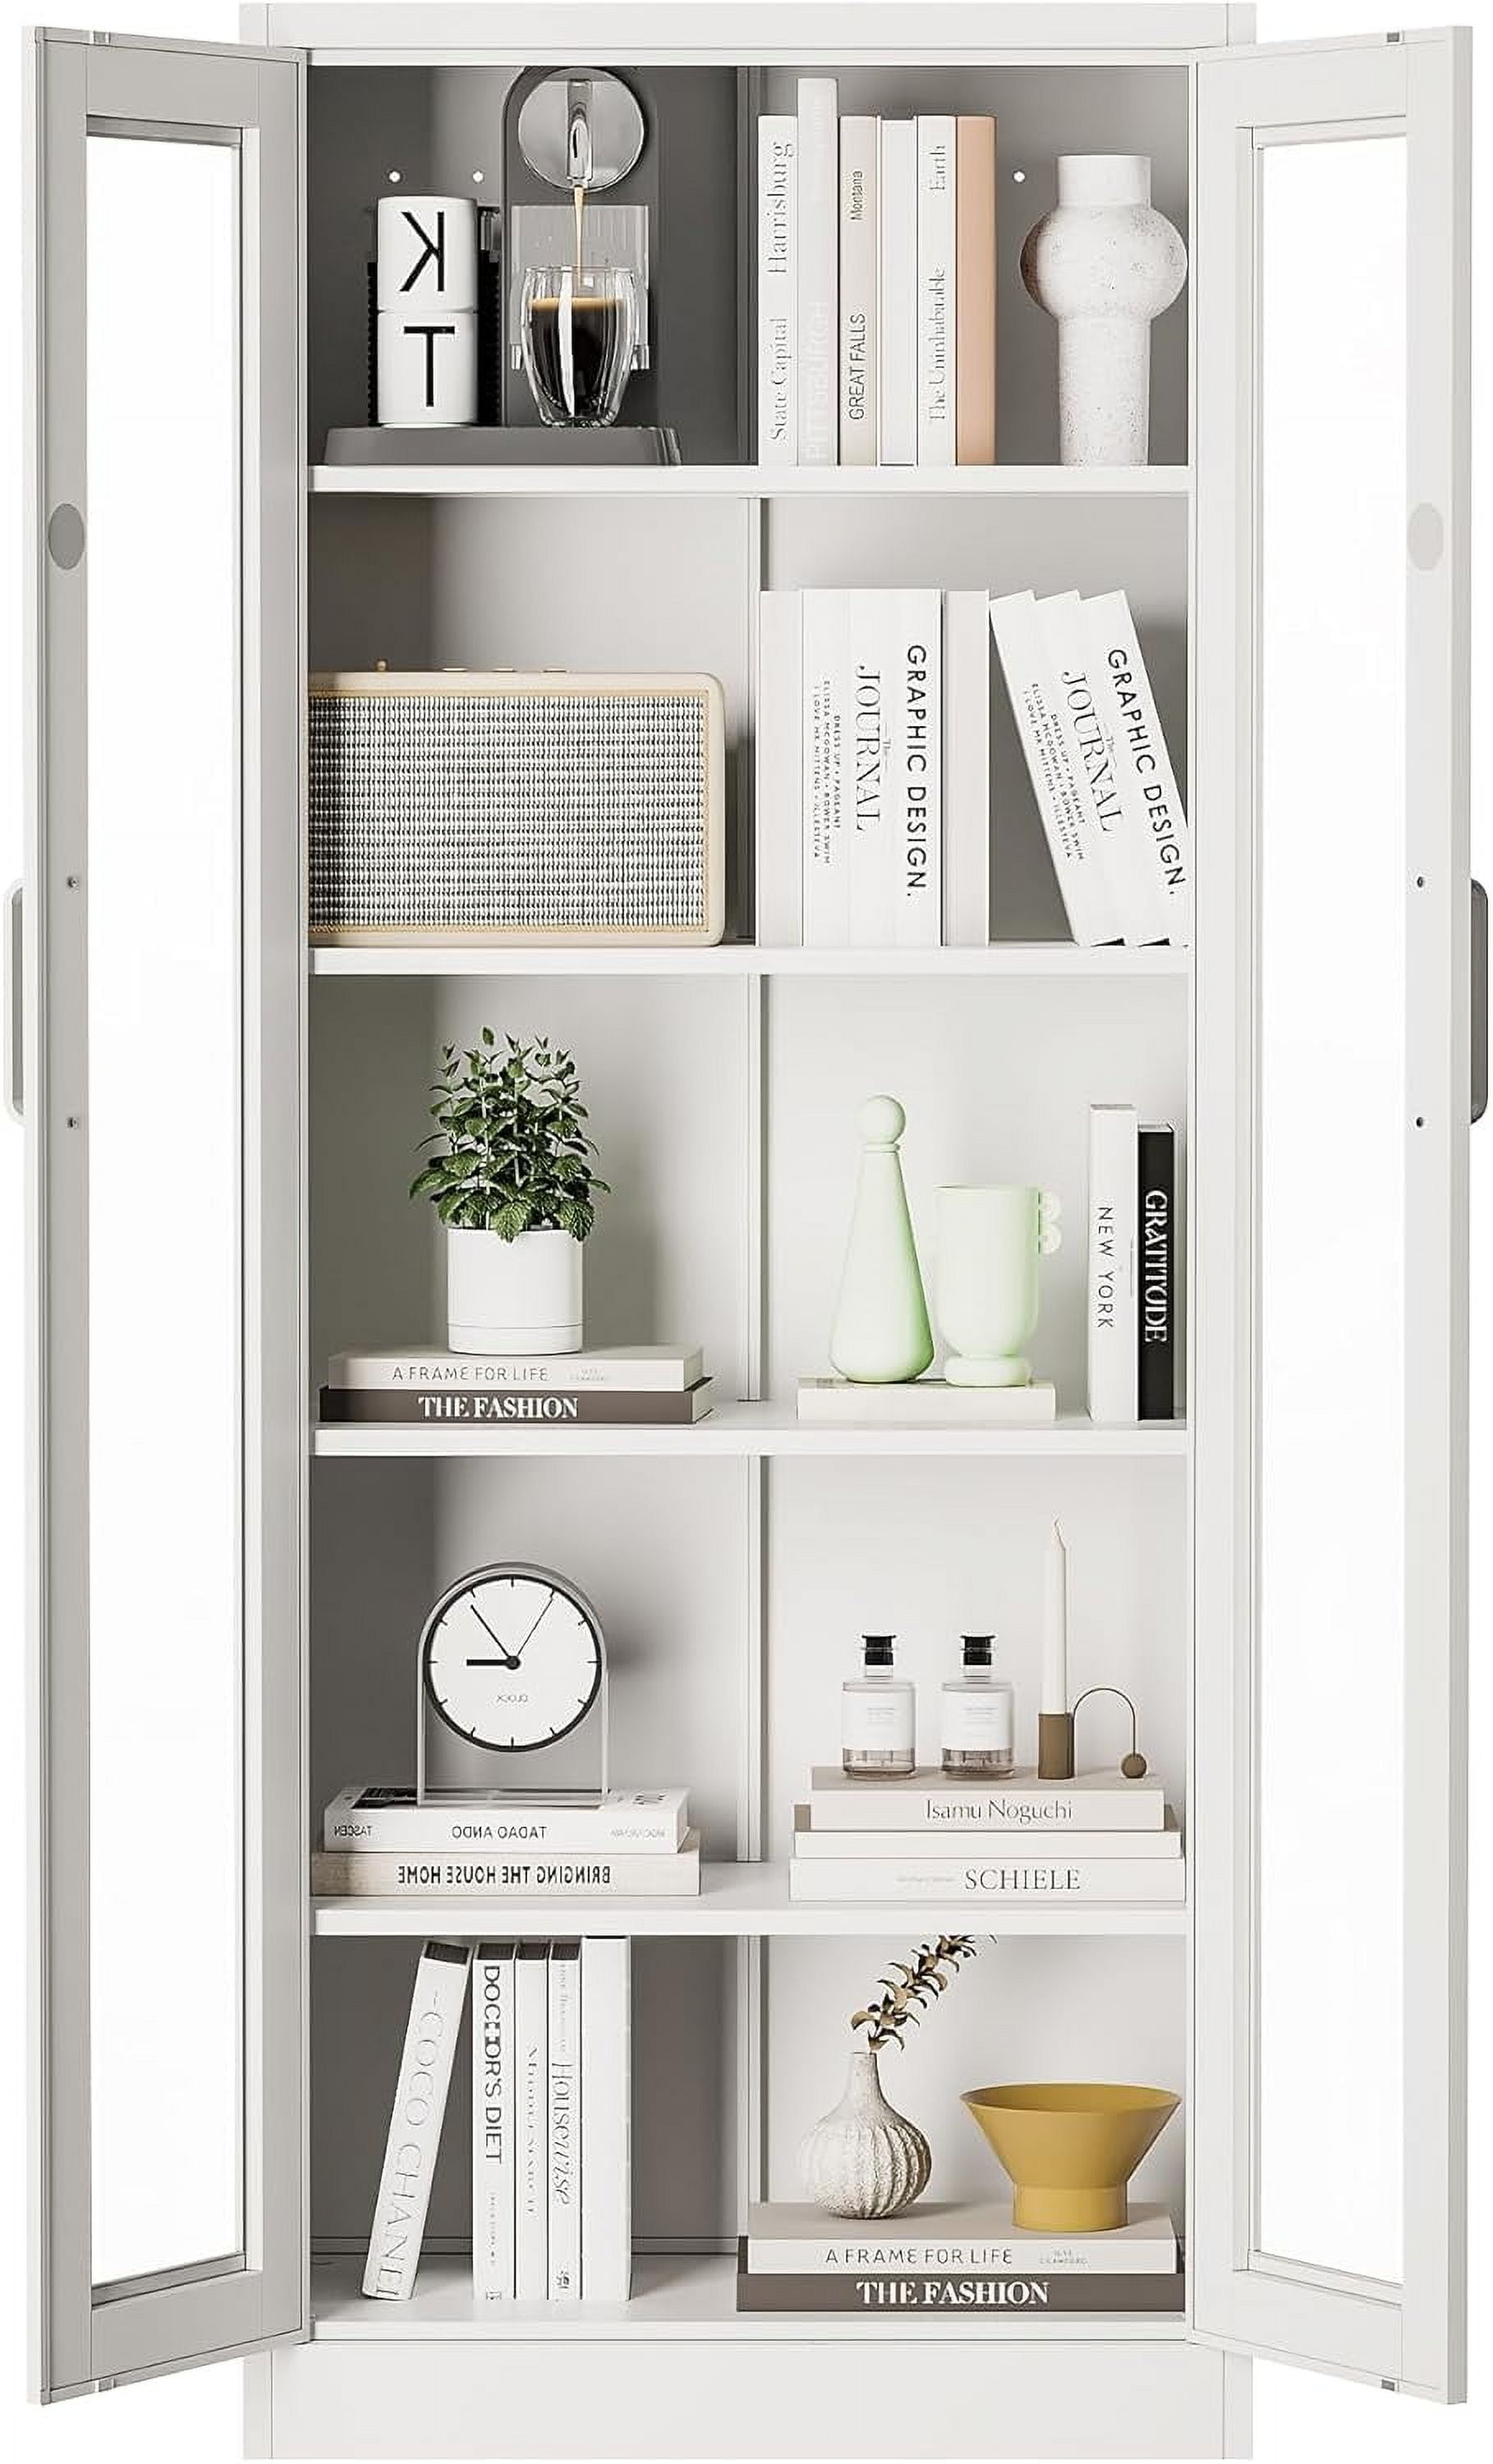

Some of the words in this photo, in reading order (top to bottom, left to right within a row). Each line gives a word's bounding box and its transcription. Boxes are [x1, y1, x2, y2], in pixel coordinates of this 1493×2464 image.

[849, 170, 864, 221] Montana
[929, 144, 947, 192] Earth
[766, 141, 794, 275] Harrisburg
[769, 317, 792, 388] Capital
[849, 313, 866, 361] FALLS
[403, 325, 455, 407] T
[849, 365, 866, 421] GREAT
[769, 392, 788, 442] State
[928, 390, 946, 421] The
[907, 645, 927, 772] GRAPHIC
[854, 664, 880, 831] JOURNAL
[1061, 670, 1121, 831] JOURNAL
[1107, 648, 1156, 775] GRAPHIC
[1142, 784, 1187, 895] DESIGN.
[907, 787, 927, 897] DESIGN.
[1097, 1206, 1114, 1257] NEW
[1144, 1189, 1169, 1343] GRATITUDE
[1097, 1271, 1114, 1329] YORK
[393, 1366, 403, 1381] A
[409, 1366, 467, 1381] FRAME
[475, 1366, 507, 1381] FOR
[513, 1366, 549, 1381] LIFE
[418, 1395, 471, 1418] THE
[474, 1395, 579, 1418] FASHION
[926, 1800, 982, 1819] Isamu
[987, 1799, 1073, 1824] Noguchi
[965, 1869, 1080, 1890] SCHIELE
[404, 2011, 445, 2126] COCO
[485, 2107, 503, 2164] DIET
[825, 2248, 838, 2264] A
[845, 2248, 917, 2264] FRAME
[926, 2249, 967, 2264] FOR
[971, 2249, 1013, 2264] LIFE
[857, 2282, 918, 2304] THE
[924, 2282, 1050, 2305] FASHION
